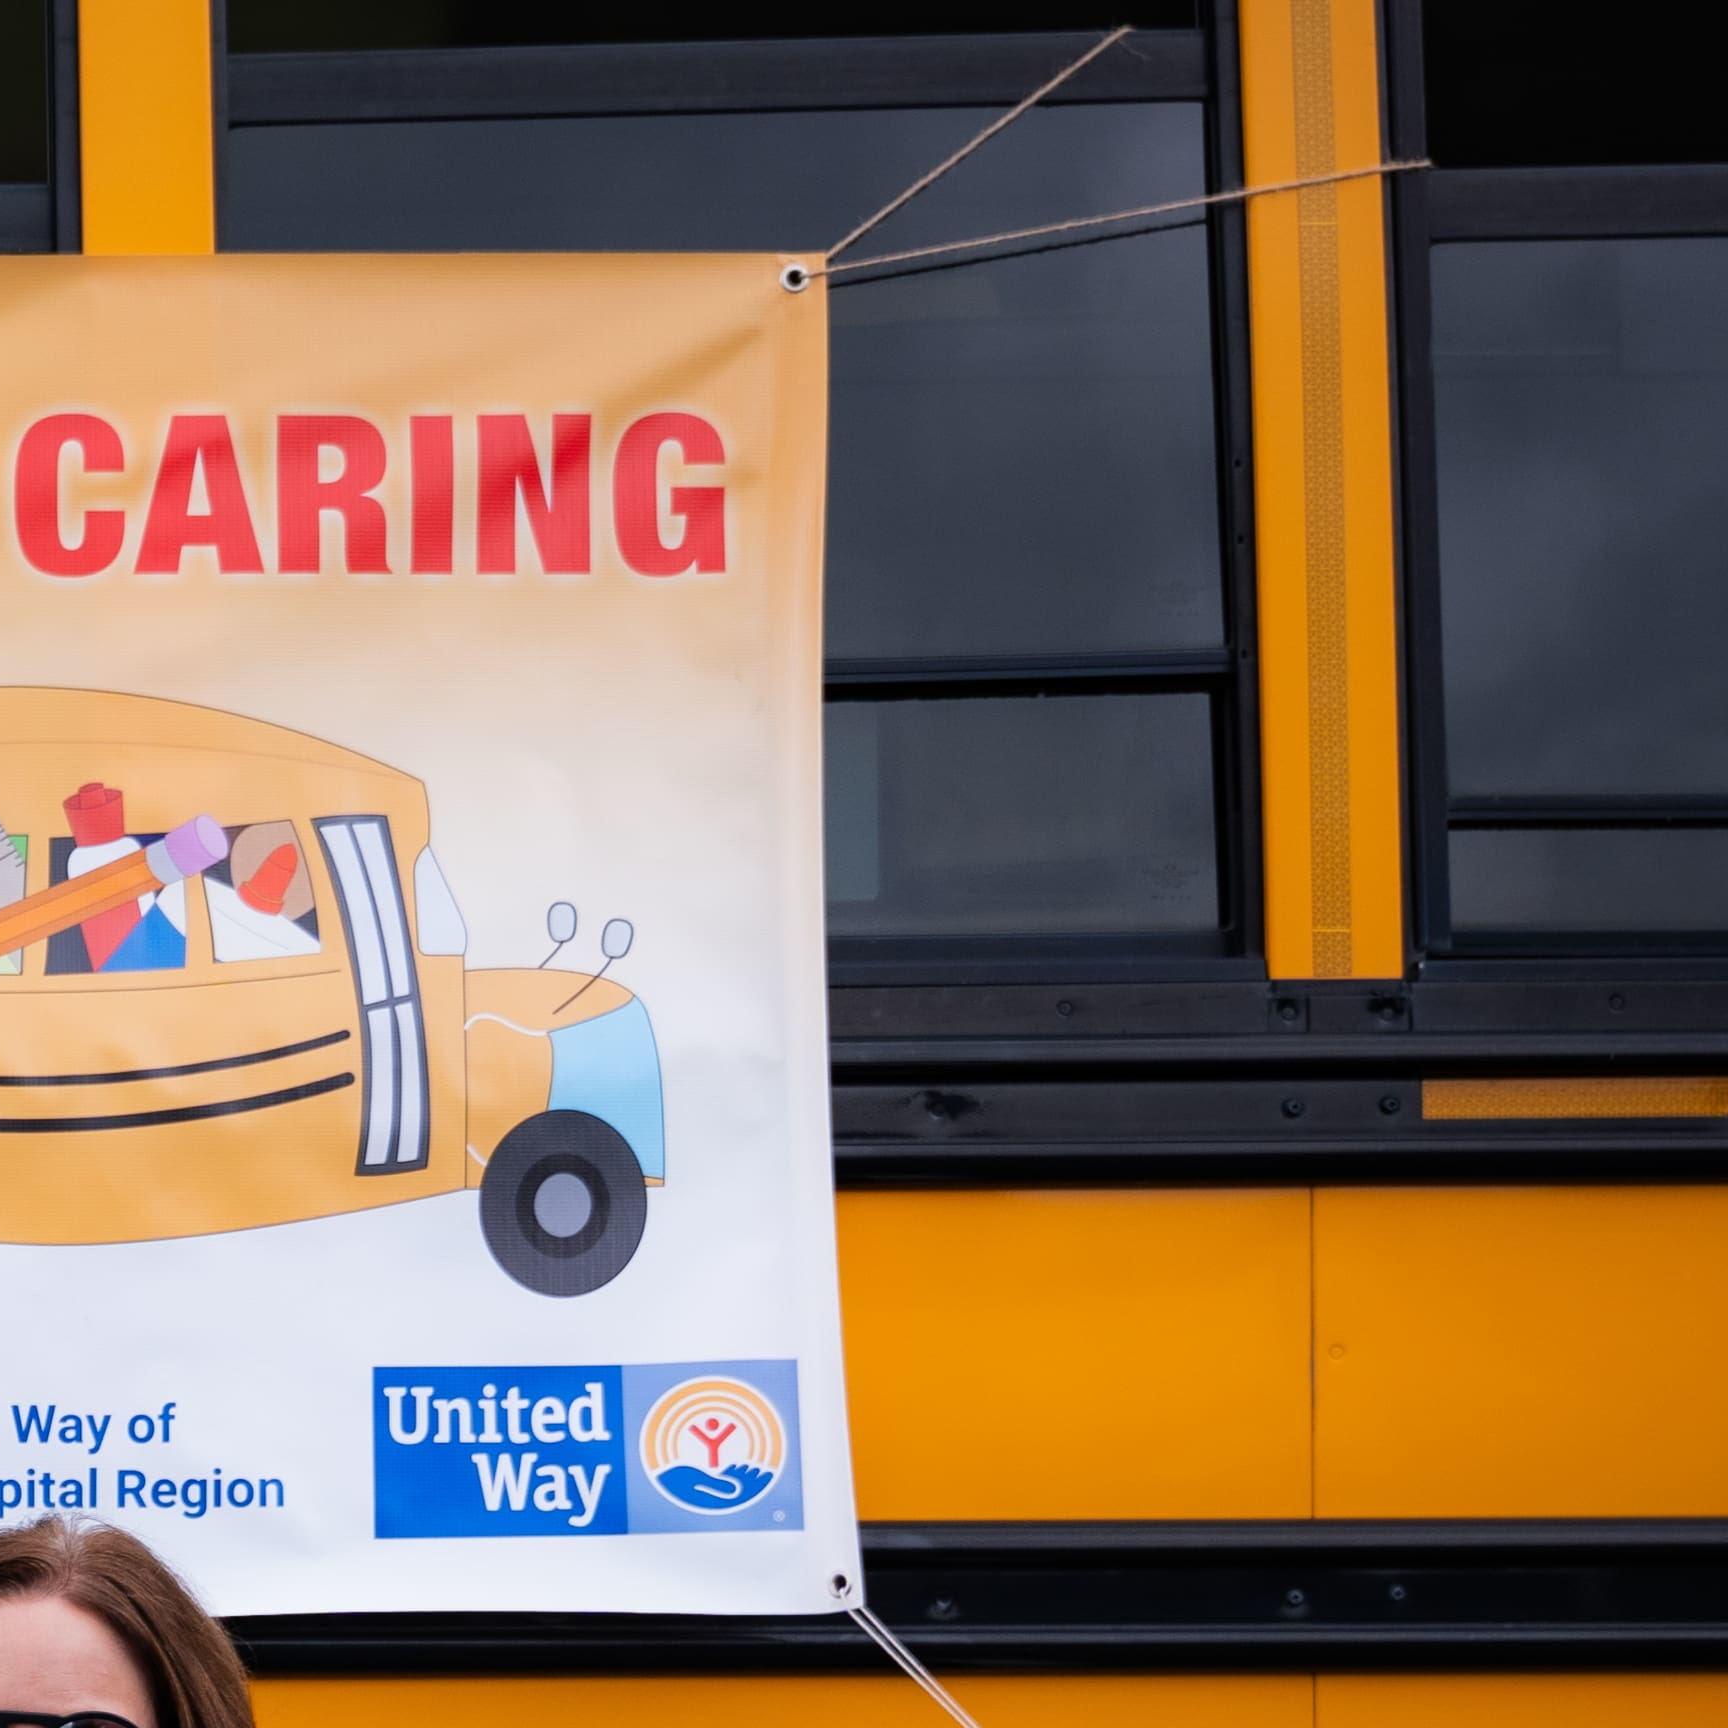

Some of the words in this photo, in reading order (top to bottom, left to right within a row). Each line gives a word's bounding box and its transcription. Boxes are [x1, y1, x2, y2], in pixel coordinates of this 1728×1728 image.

[14, 411, 727, 577] CARING
[11, 1404, 112, 1455] Way
[127, 1402, 177, 1444] of
[382, 1382, 611, 1445] United
[117, 1467, 285, 1519] Region
[471, 1452, 611, 1527] Way
